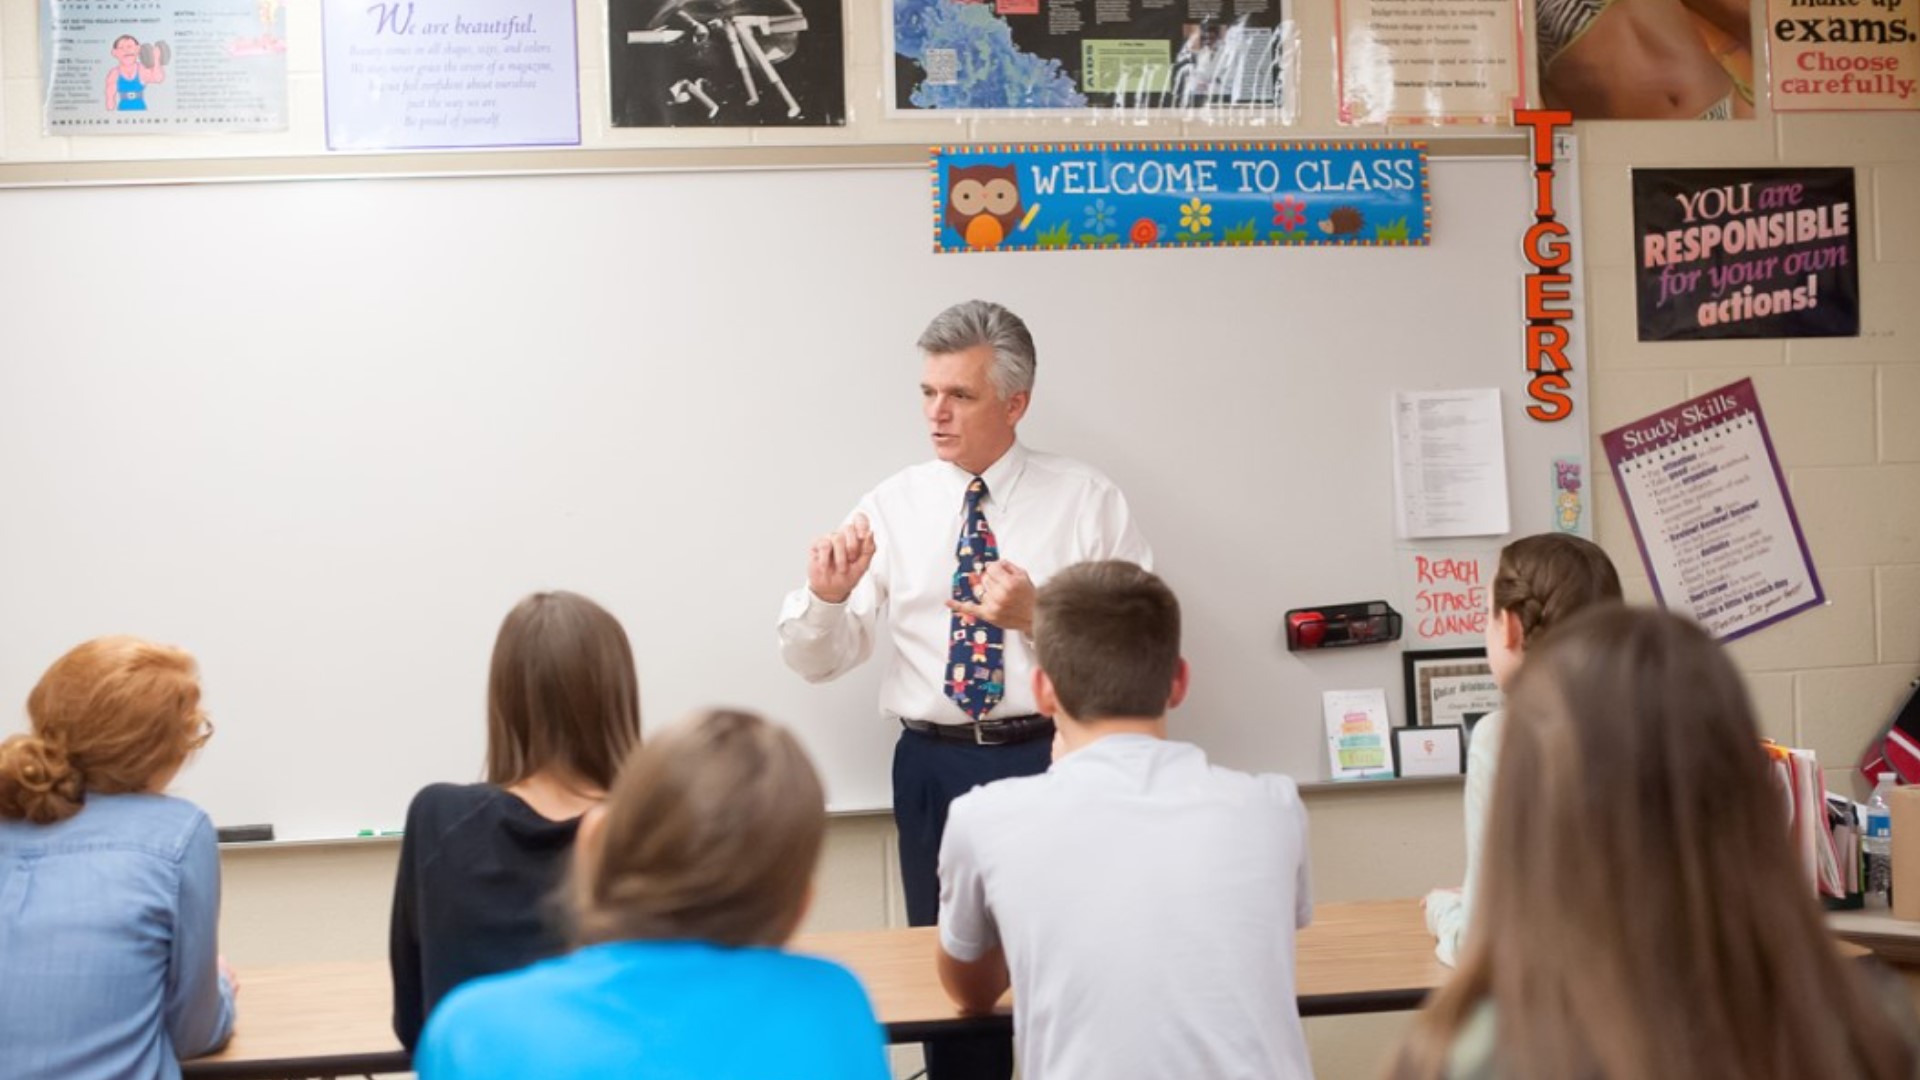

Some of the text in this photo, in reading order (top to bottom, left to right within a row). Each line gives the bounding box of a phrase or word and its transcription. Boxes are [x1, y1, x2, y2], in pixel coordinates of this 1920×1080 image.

[367, 2, 537, 40] We are beautiful.
[1775, 18, 1917, 44] exams.
[1796, 51, 1899, 71] Choose
[1781, 73, 1917, 99] carefully.
[1031, 158, 1416, 196] WELCOME TO CLASS
[1675, 182, 1804, 223] YOU are
[1644, 202, 1850, 269] RESPONSIBLE
[1514, 108, 1574, 423] TIGERS
[1656, 244, 1848, 308] for your own
[1697, 273, 1818, 327] actions!
[1622, 394, 1738, 450] Study Skills
[1415, 555, 1479, 586] REACH
[1418, 611, 1488, 639] CONNE
